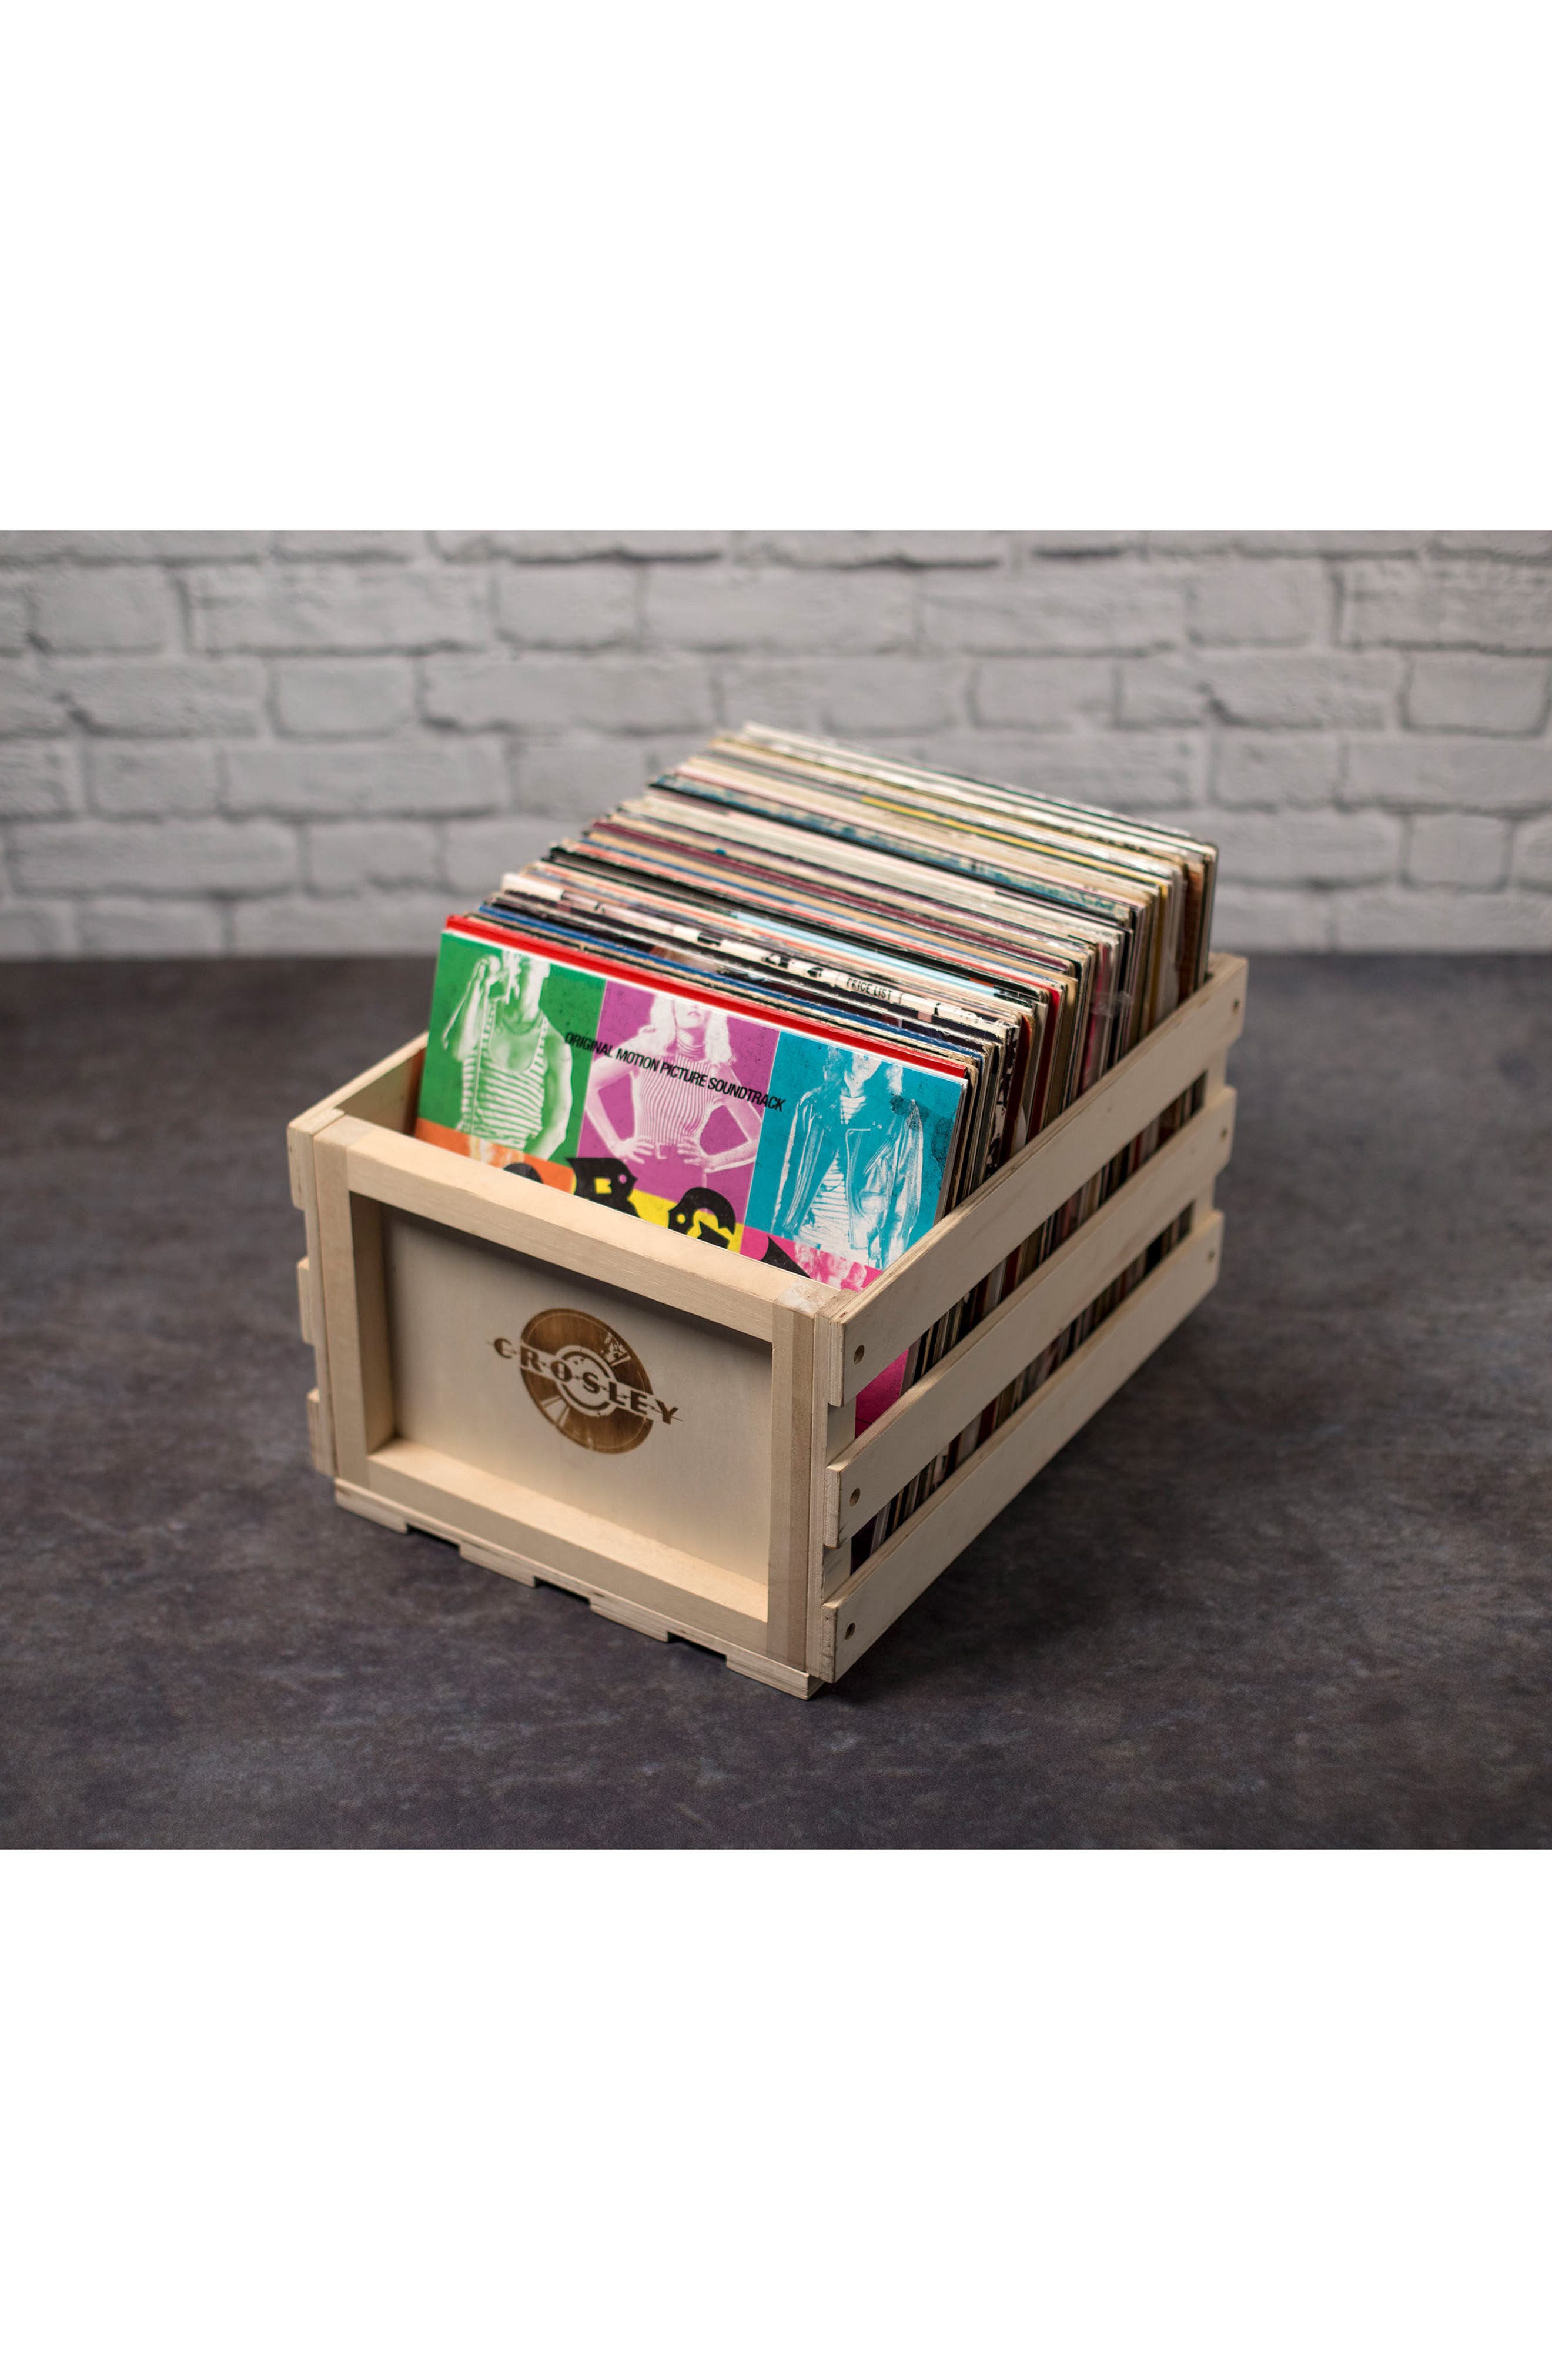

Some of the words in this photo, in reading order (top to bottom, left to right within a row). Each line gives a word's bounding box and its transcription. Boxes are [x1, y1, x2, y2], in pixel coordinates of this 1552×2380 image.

[847, 978, 872, 995] PRICE
[874, 986, 893, 1000] LIST
[564, 1032, 614, 1058] ORIGINAL
[615, 1048, 660, 1072] MOTION
[659, 1062, 708, 1087] PICTURE
[707, 1078, 787, 1112] SOUNDTRACK
[493, 1336, 680, 1425] CROSLEY
